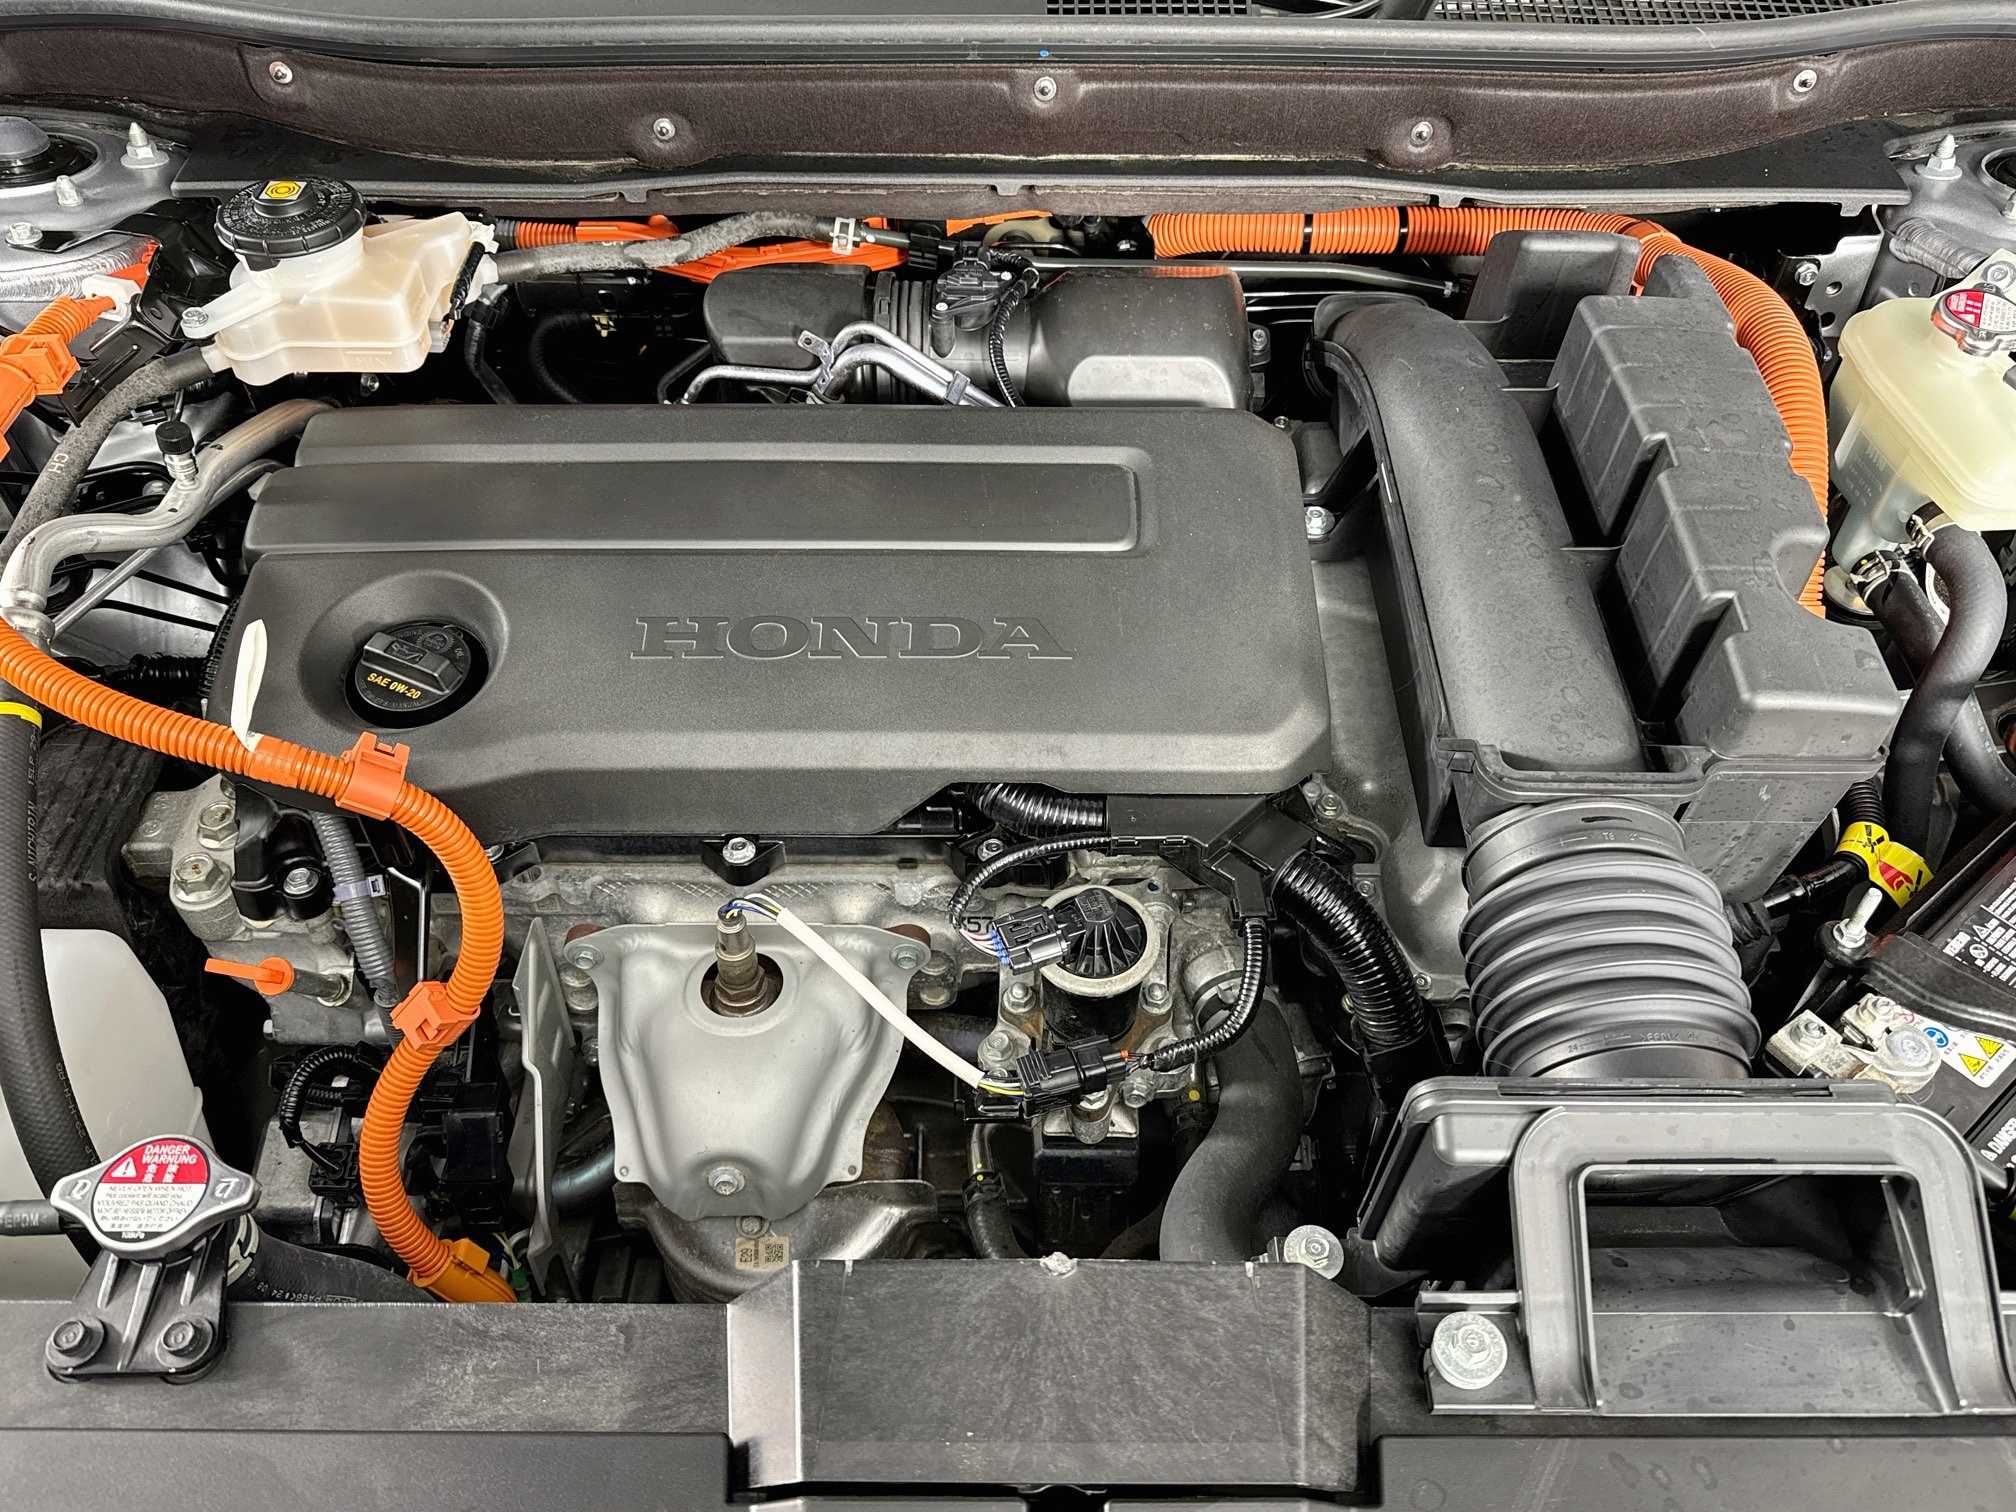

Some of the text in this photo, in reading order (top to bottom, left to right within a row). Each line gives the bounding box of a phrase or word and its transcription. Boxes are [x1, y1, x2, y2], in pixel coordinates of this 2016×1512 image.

[48, 453, 69, 474] CH
[630, 615, 1074, 660] HONDA
[367, 672, 422, 700] SAE 0W-20
[144, 1144, 191, 1155] DANGER
[142, 1154, 198, 1165] WARNUNG
[740, 1247, 753, 1263] E29
